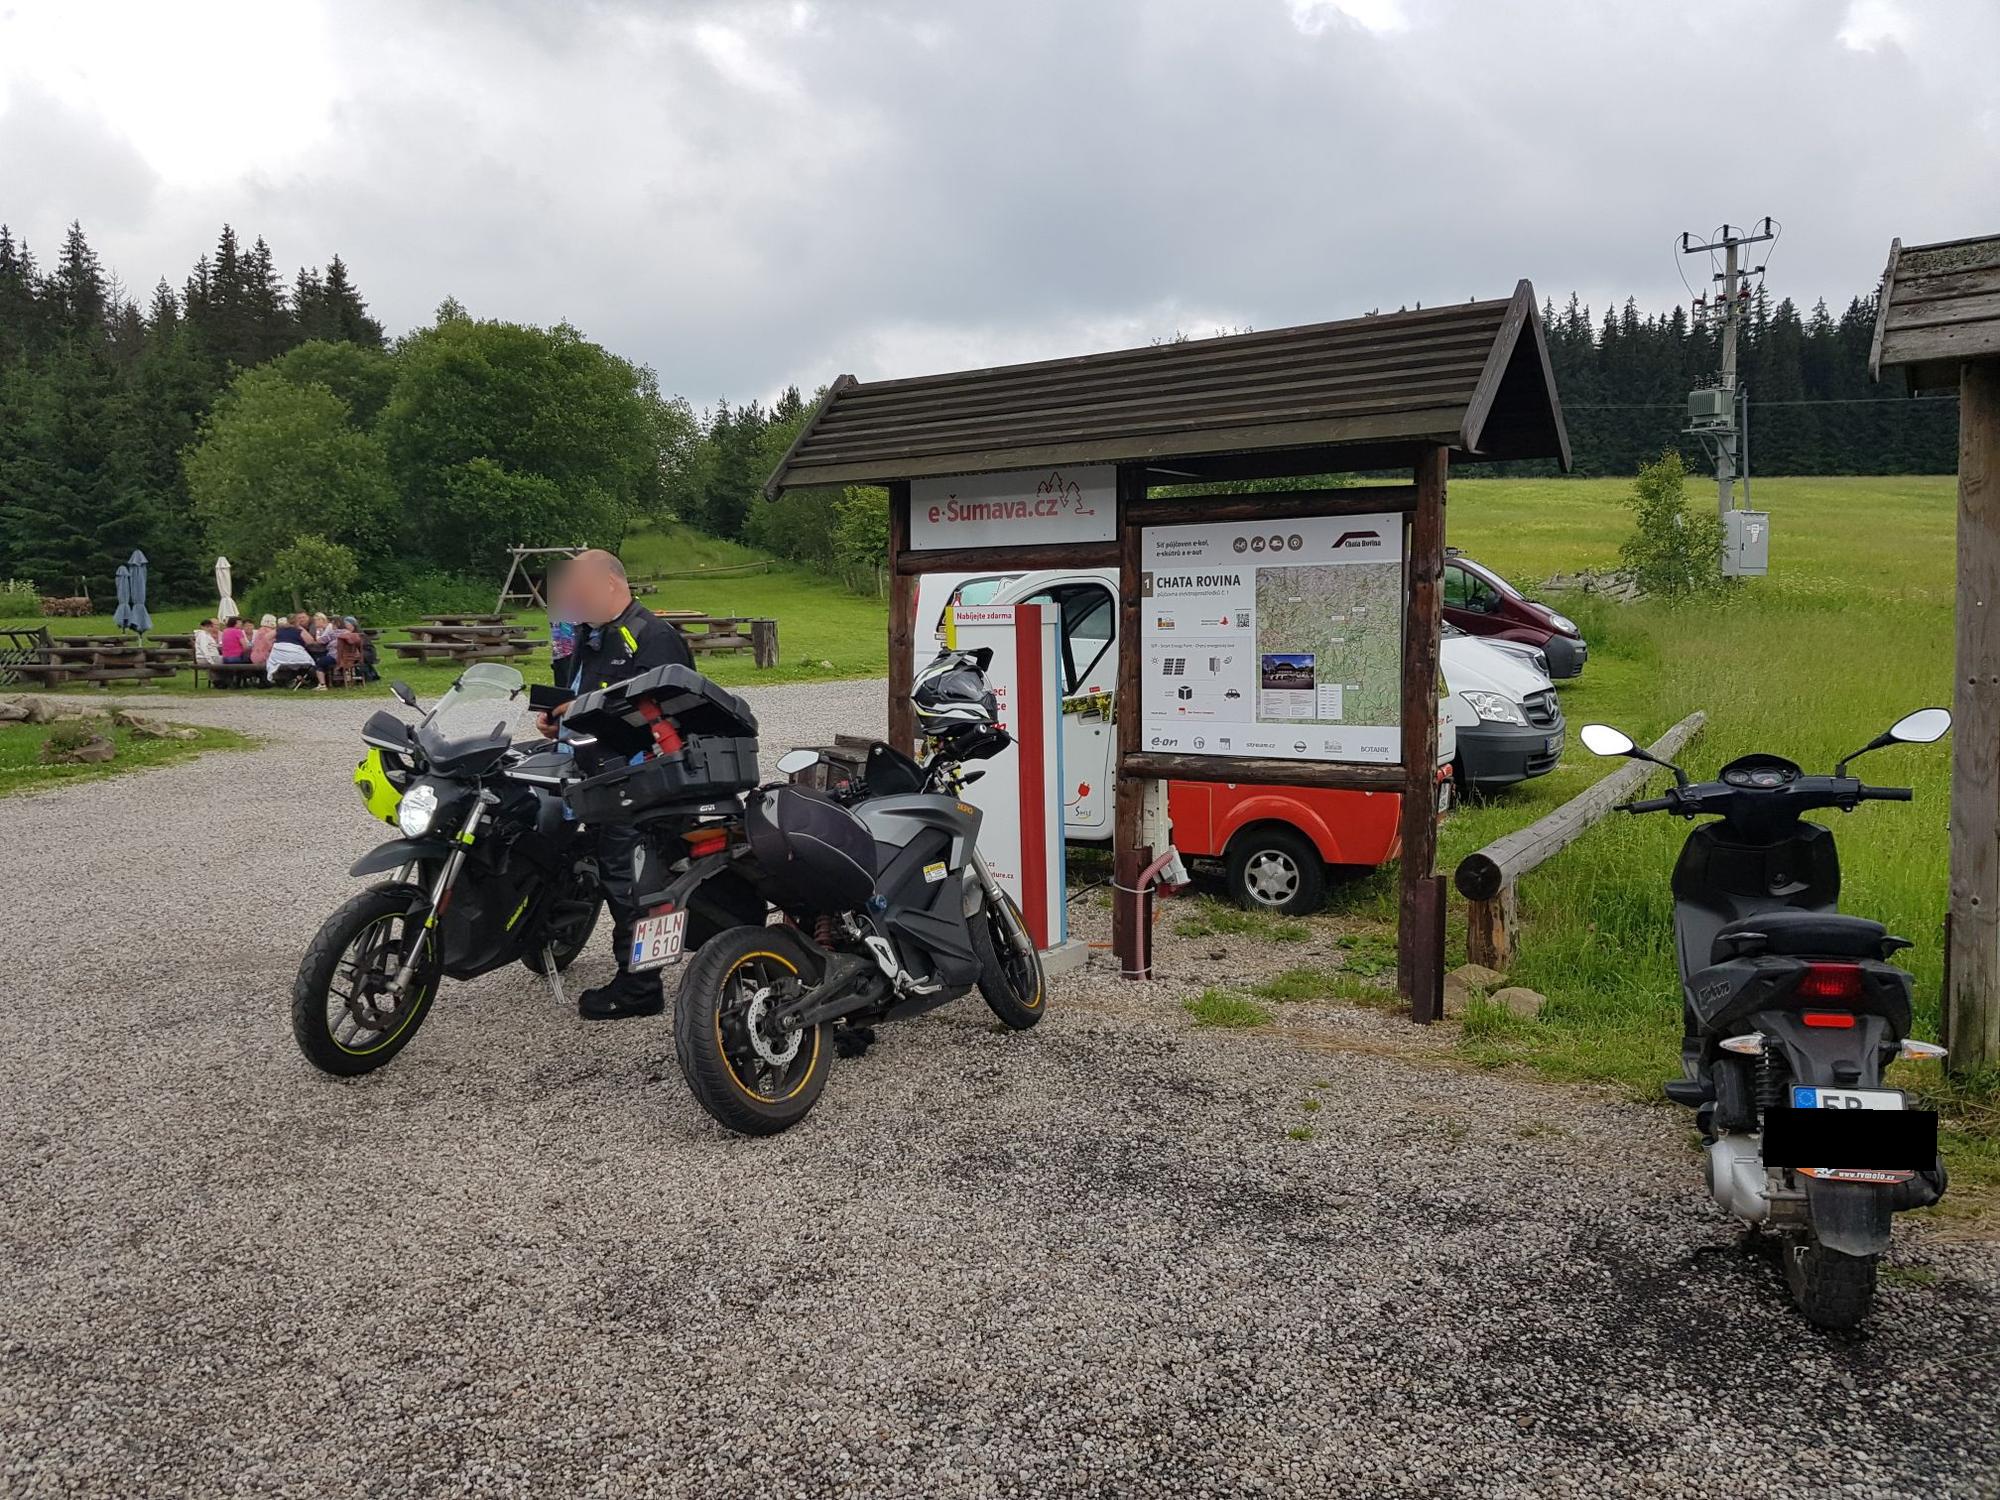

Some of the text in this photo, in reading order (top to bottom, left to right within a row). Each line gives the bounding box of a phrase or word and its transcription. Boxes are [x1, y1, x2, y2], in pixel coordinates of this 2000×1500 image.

[1144, 578, 1150, 589] 1
[1156, 574, 1241, 589] CHATA ROVINA
[956, 611, 1012, 622] Nabíjejte zdarma
[652, 935, 680, 957] 610
